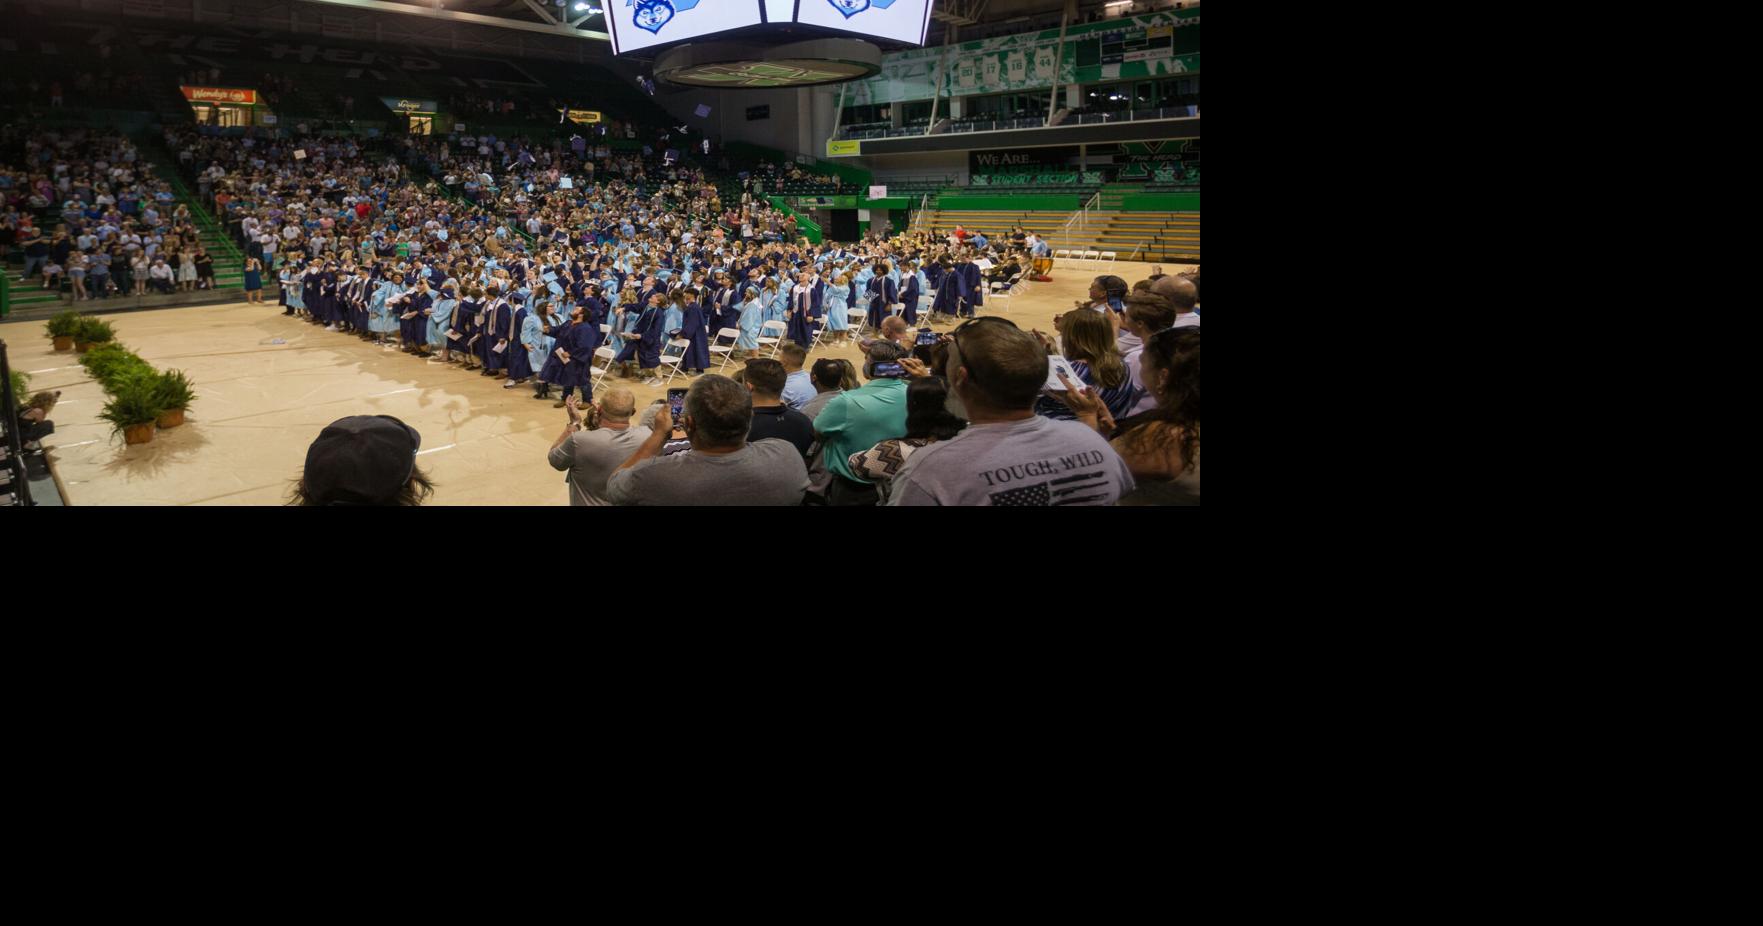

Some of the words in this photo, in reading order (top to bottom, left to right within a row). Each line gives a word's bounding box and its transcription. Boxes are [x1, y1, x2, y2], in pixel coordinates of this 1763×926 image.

[192, 89, 228, 100] Wendy's
[979, 460, 1059, 486] TOUGH,
[1060, 450, 1104, 470] WILD
